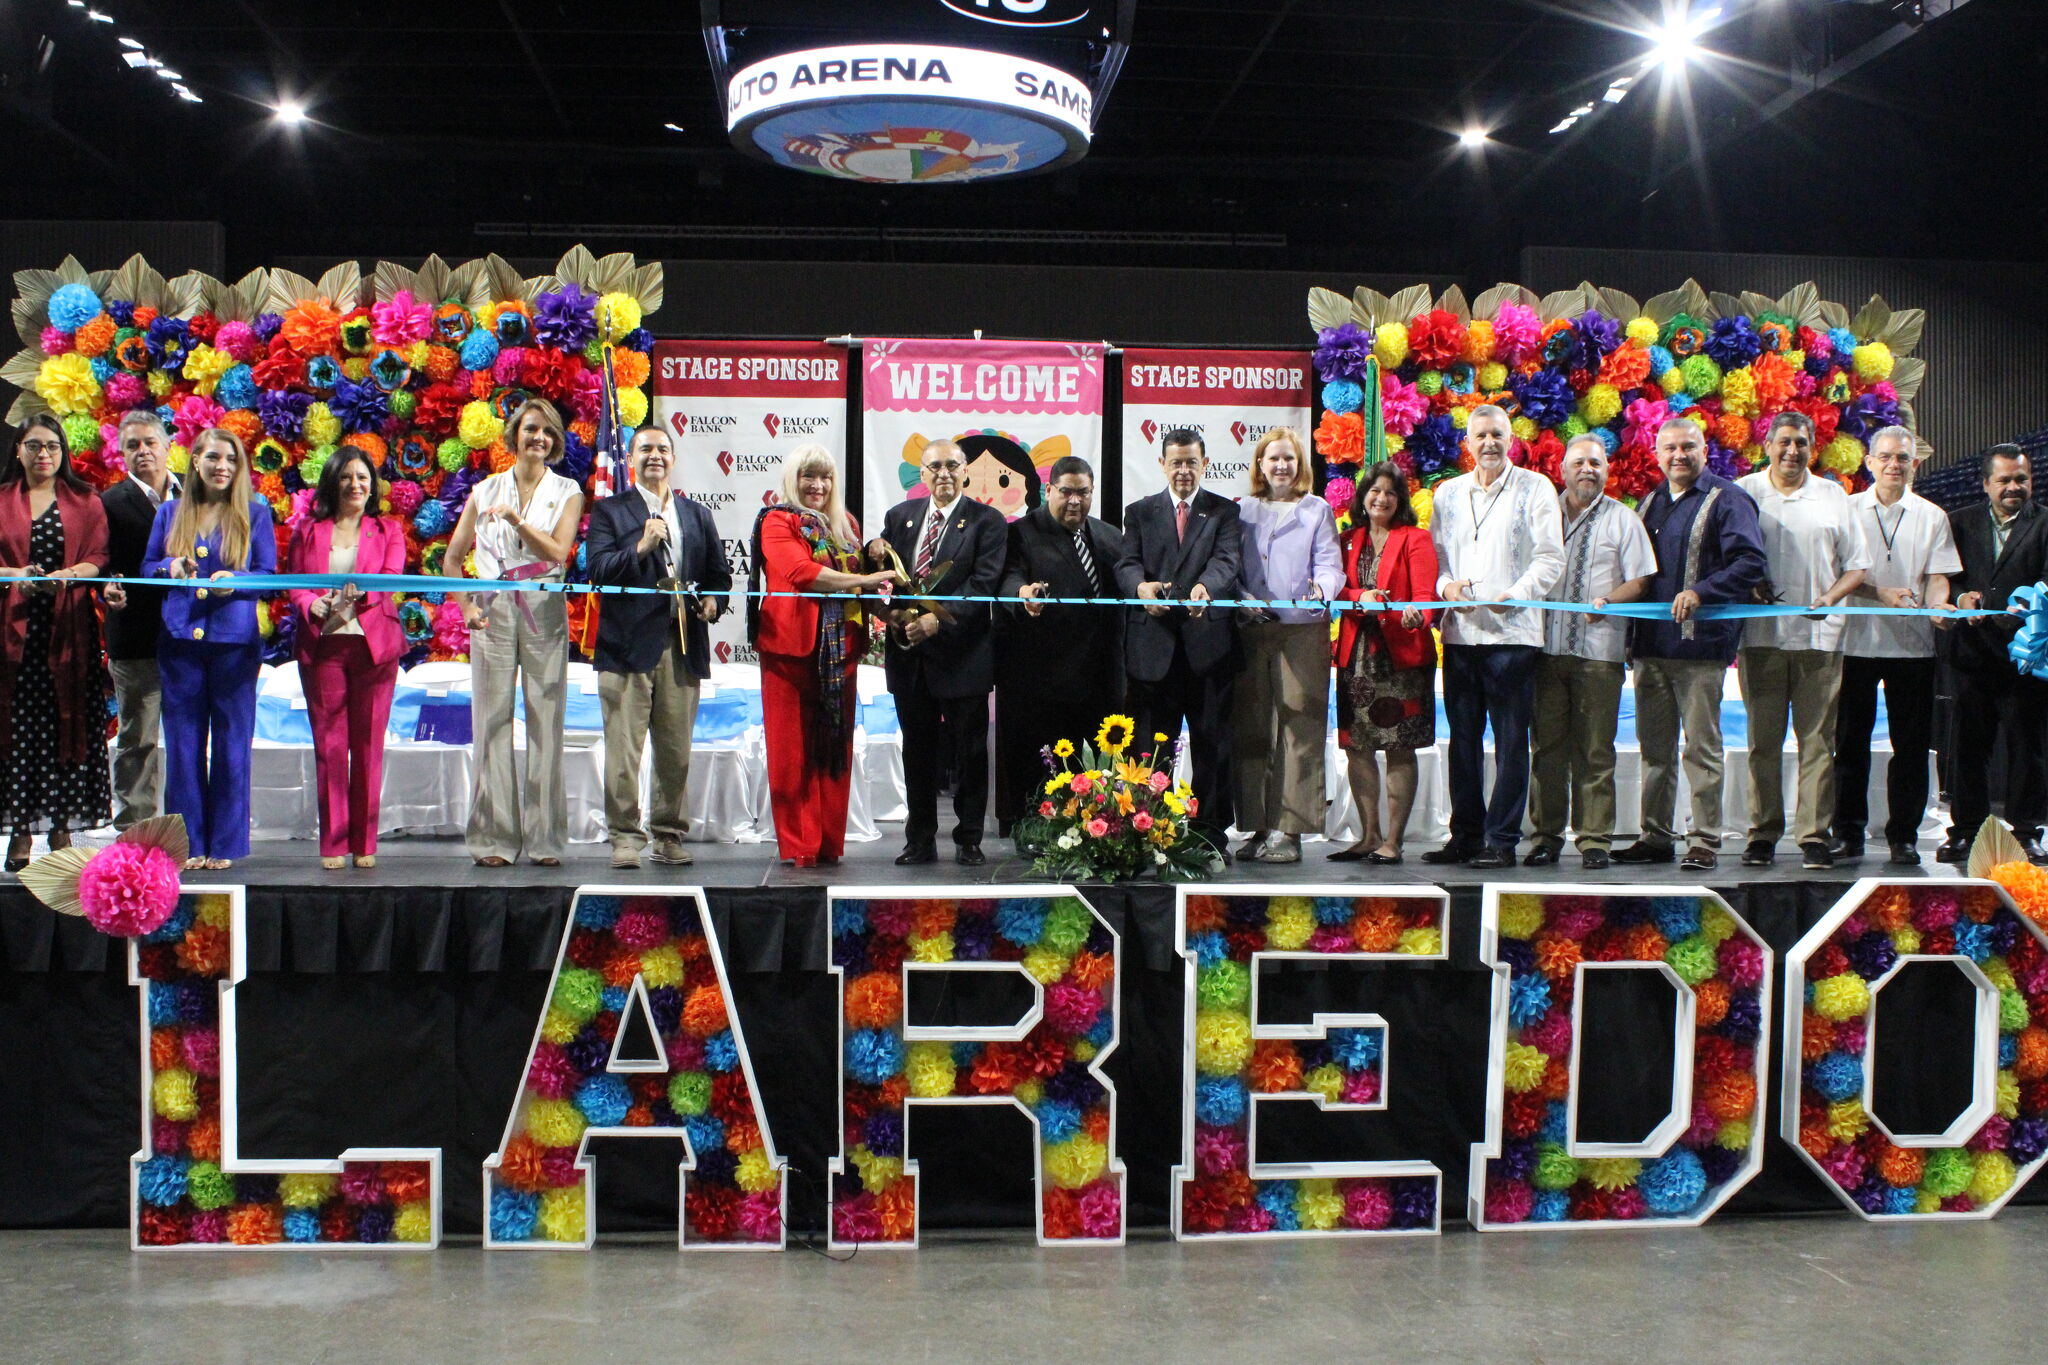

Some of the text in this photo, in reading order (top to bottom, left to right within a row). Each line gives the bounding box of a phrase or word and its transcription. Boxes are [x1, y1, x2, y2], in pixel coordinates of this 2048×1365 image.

[730, 58, 1091, 122] UTO ARENA SAME
[662, 357, 840, 381] STAGE SPONSOR
[1131, 365, 1303, 390] STAGE SPONSOR
[888, 363, 1080, 402] WELCOME
[690, 416, 737, 425] FALCON
[783, 417, 829, 426] FALCON
[691, 425, 722, 433] BANK
[783, 426, 814, 434] BANK
[736, 455, 783, 464] FALCON
[736, 464, 768, 472] BANK
[1204, 471, 1236, 479] BANK
[689, 493, 736, 502] FALCON
[129, 877, 2048, 1252] LAREDO
